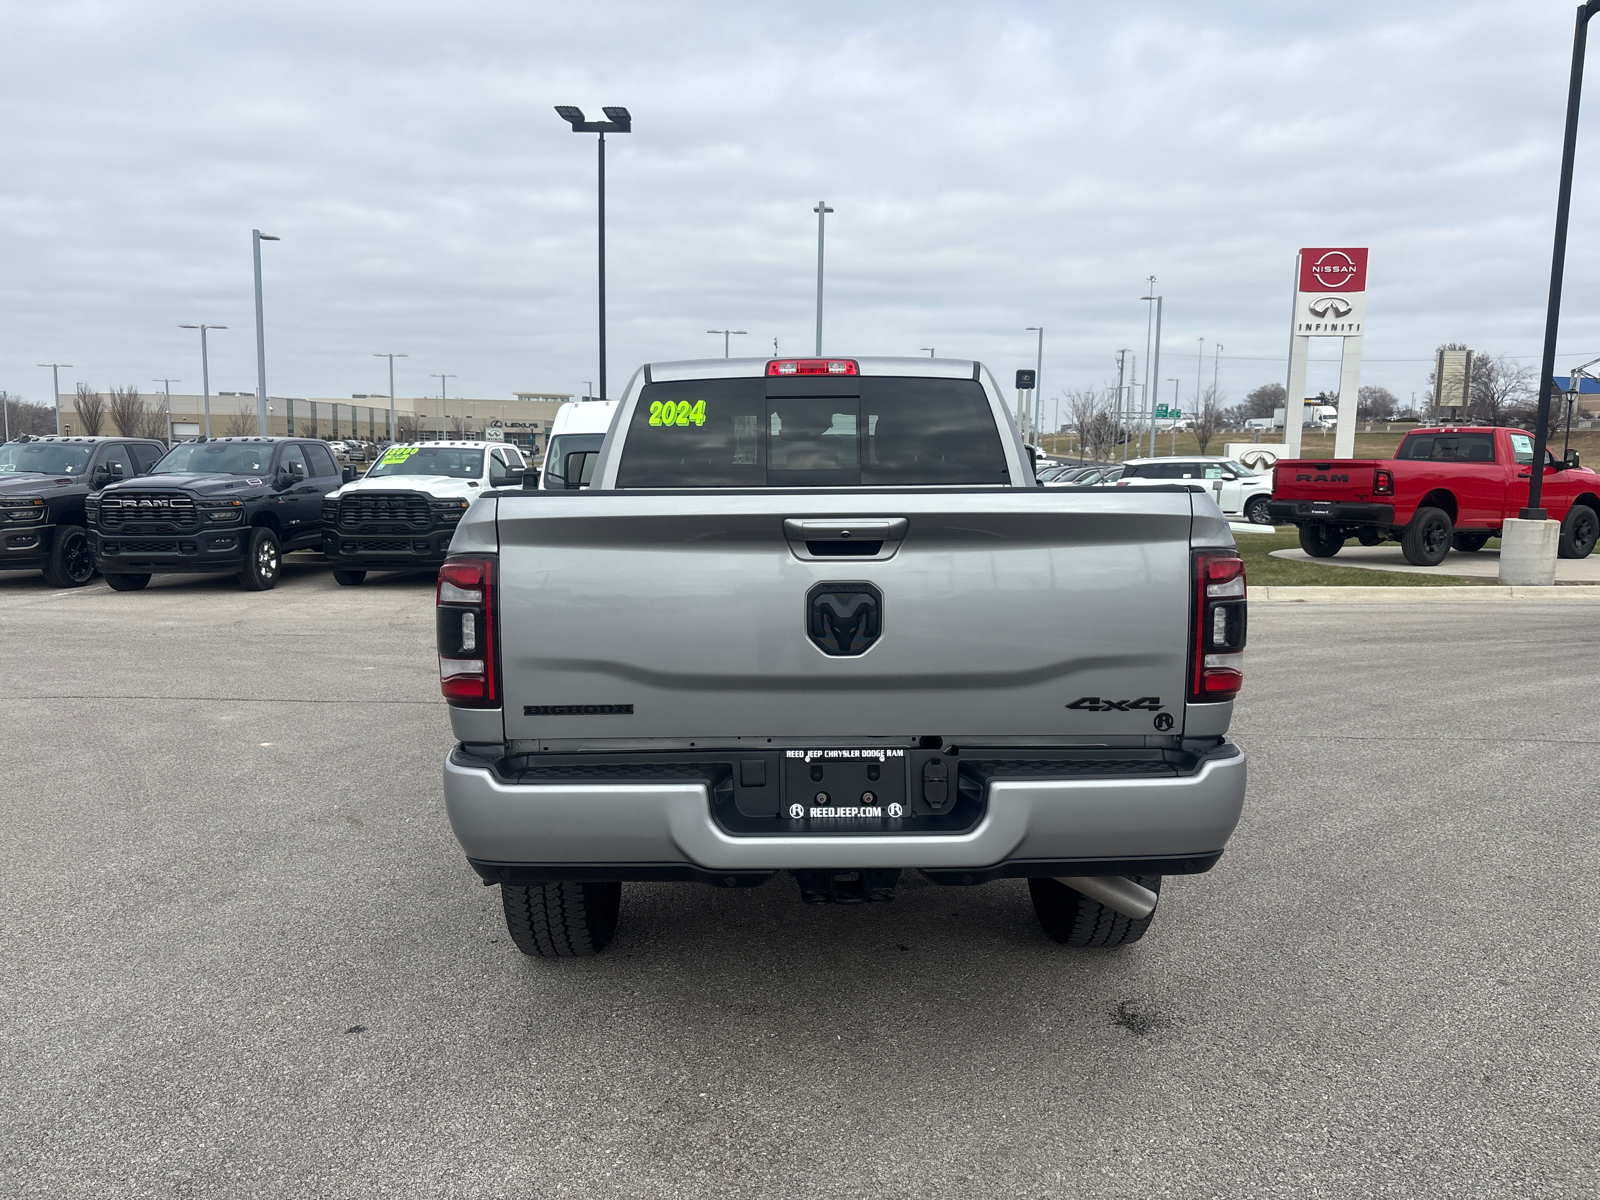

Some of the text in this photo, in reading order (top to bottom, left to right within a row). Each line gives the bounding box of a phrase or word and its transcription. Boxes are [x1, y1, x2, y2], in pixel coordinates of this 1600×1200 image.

[1298, 323, 1361, 332] INFINITI
[648, 399, 707, 427] 2024
[1296, 474, 1349, 483] RAM
[1064, 696, 1166, 712] 4x4
[523, 704, 634, 716] BIGHORN
[786, 749, 904, 758] REED JEEP CHRYSLER DODGE RAM
[810, 807, 882, 818] REEDJEEP.COM
